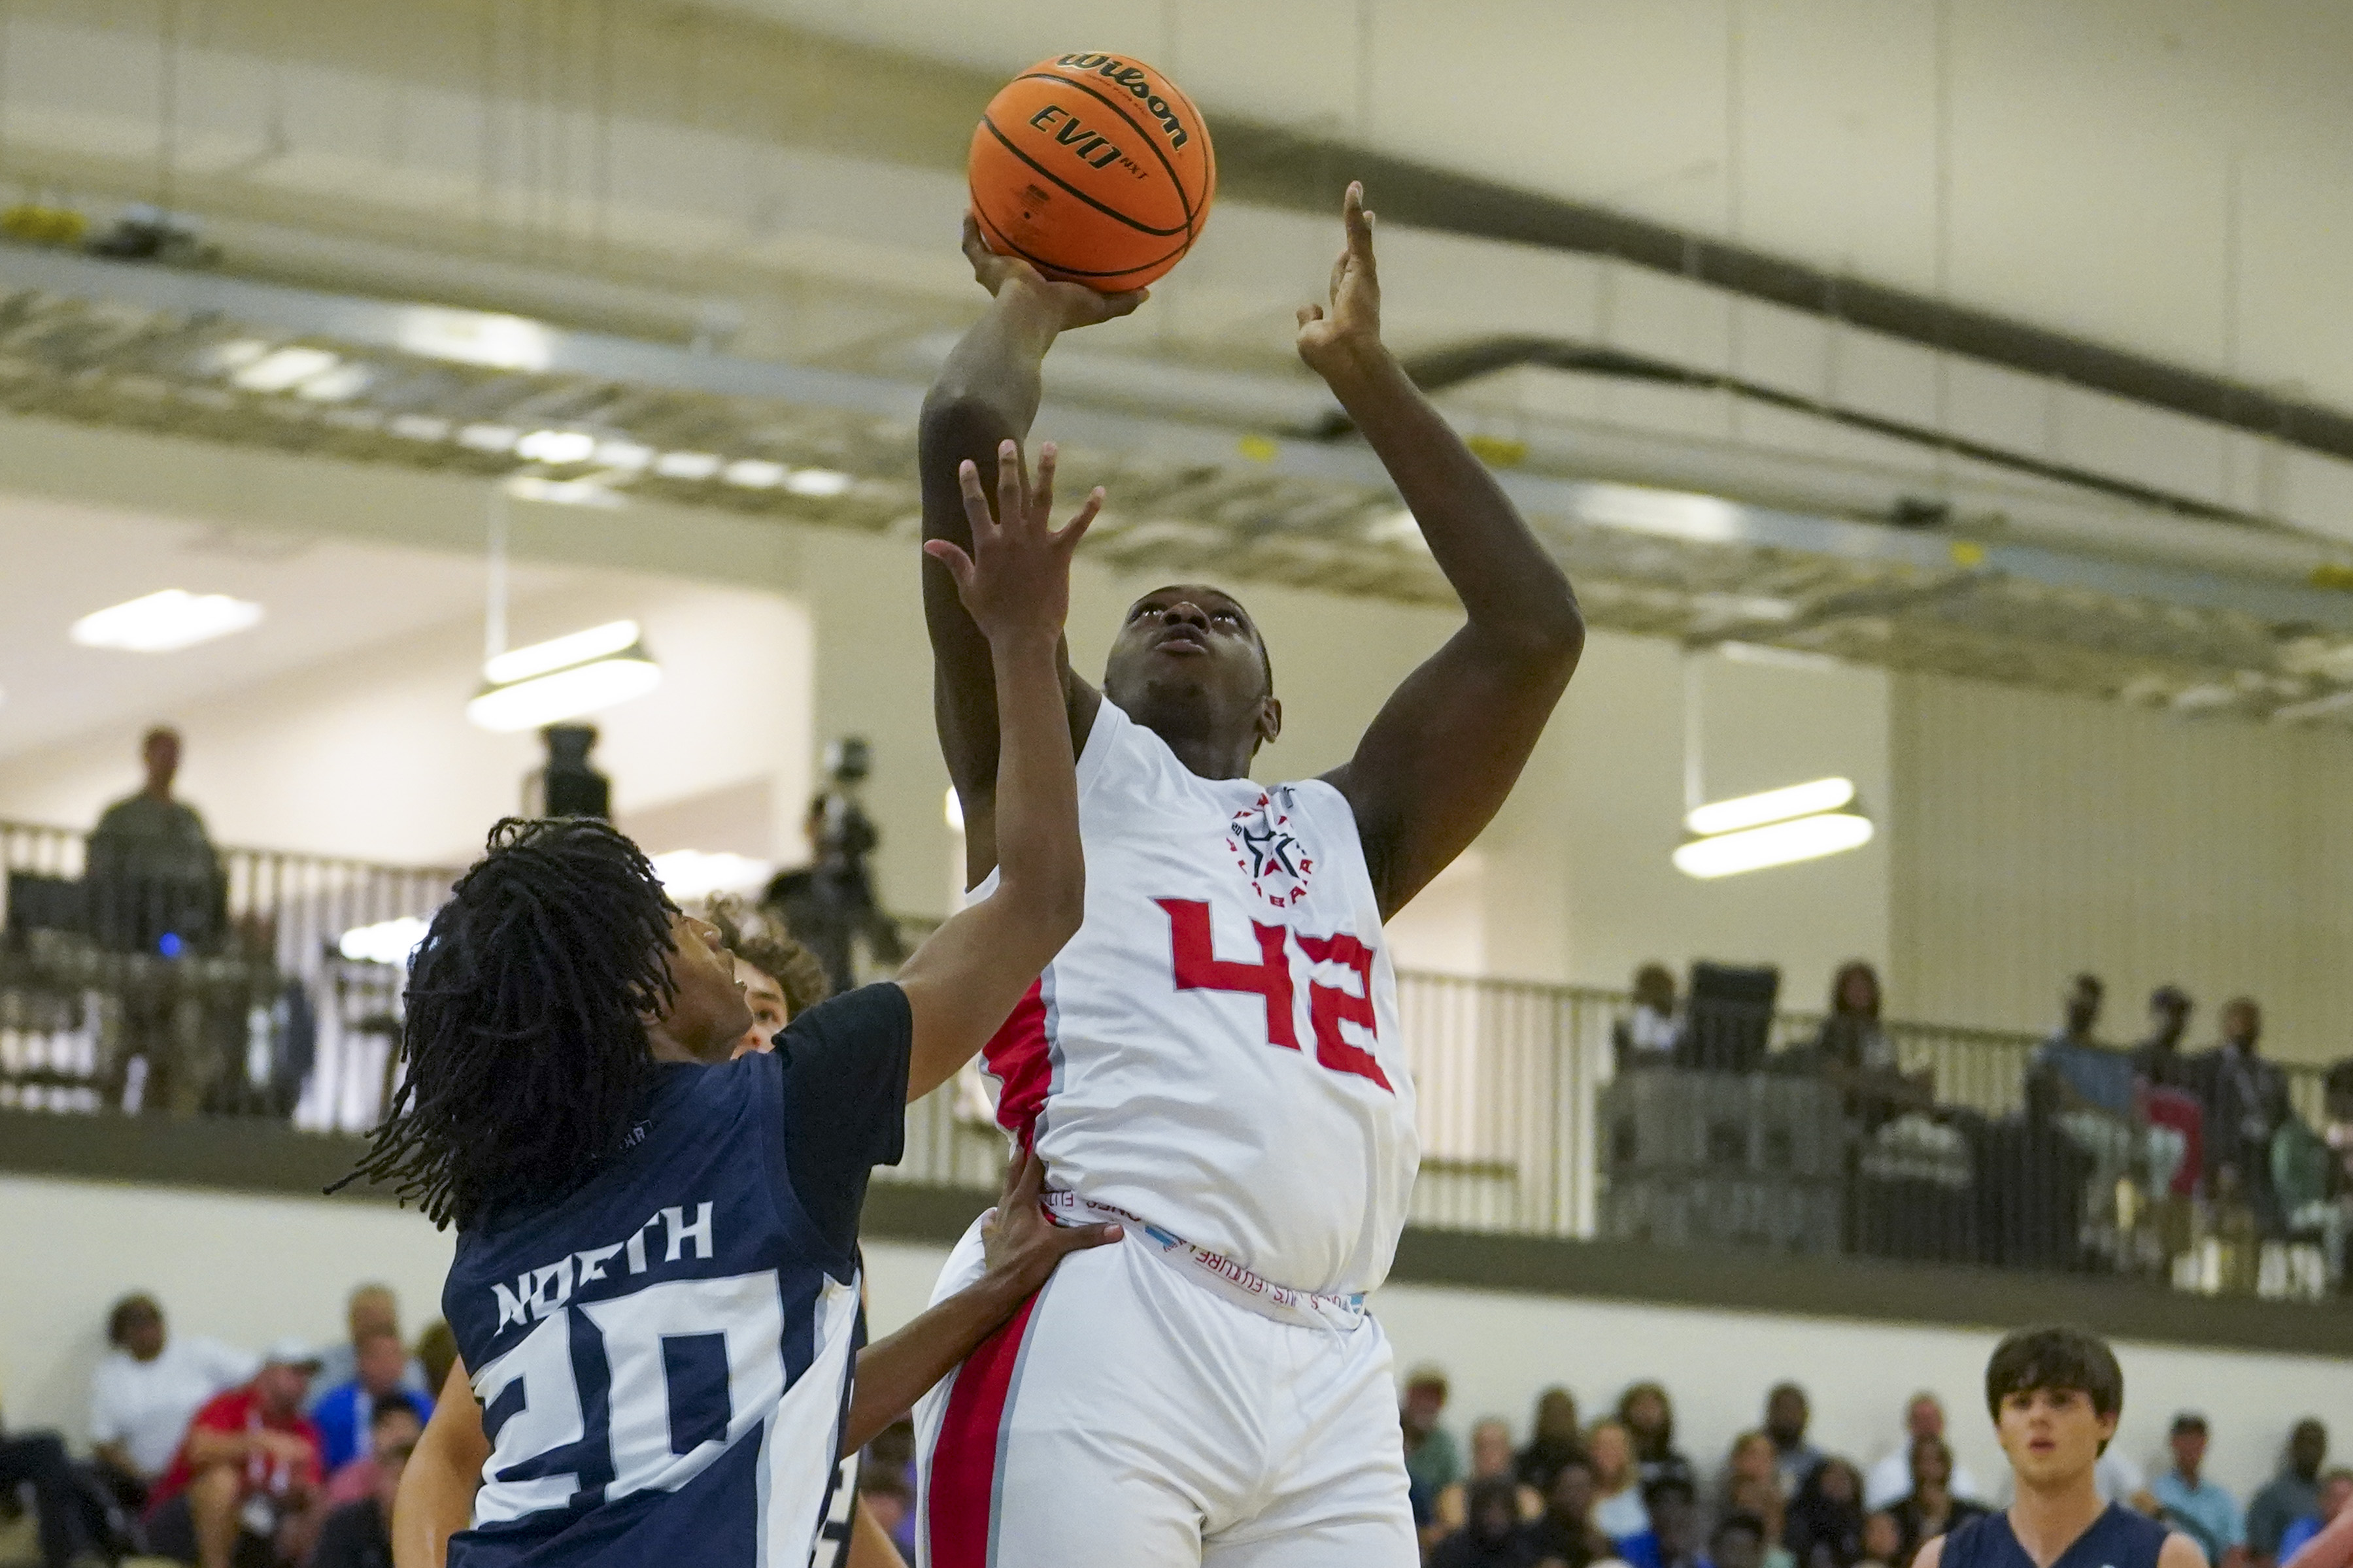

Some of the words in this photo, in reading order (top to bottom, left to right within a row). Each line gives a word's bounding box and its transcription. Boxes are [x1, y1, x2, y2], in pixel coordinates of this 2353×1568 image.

[1029, 104, 1123, 170] EVO
[1119, 156, 1147, 180] NXT
[1055, 52, 1189, 152] Wilson
[1147, 895, 1397, 1099] 42
[470, 1268, 787, 1531] 20
